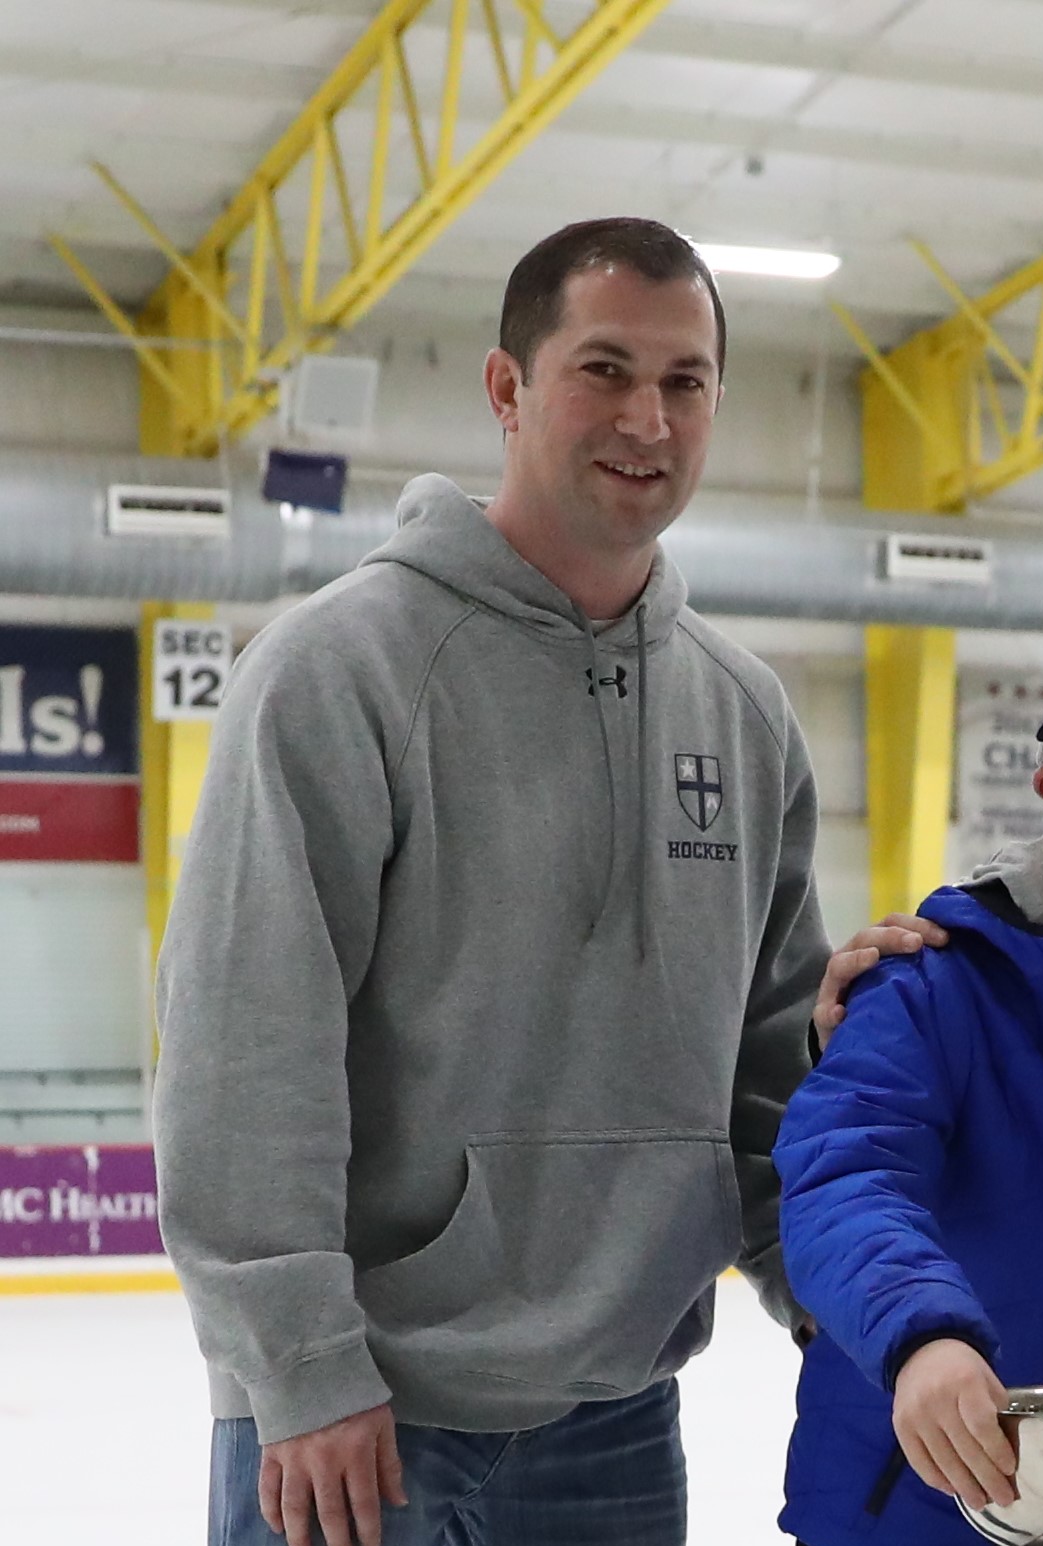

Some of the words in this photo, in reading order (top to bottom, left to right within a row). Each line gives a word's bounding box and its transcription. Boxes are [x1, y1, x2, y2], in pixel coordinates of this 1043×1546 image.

[162, 629, 223, 655] SEC
[164, 666, 219, 708] 12
[667, 841, 738, 861] HOCKEY
